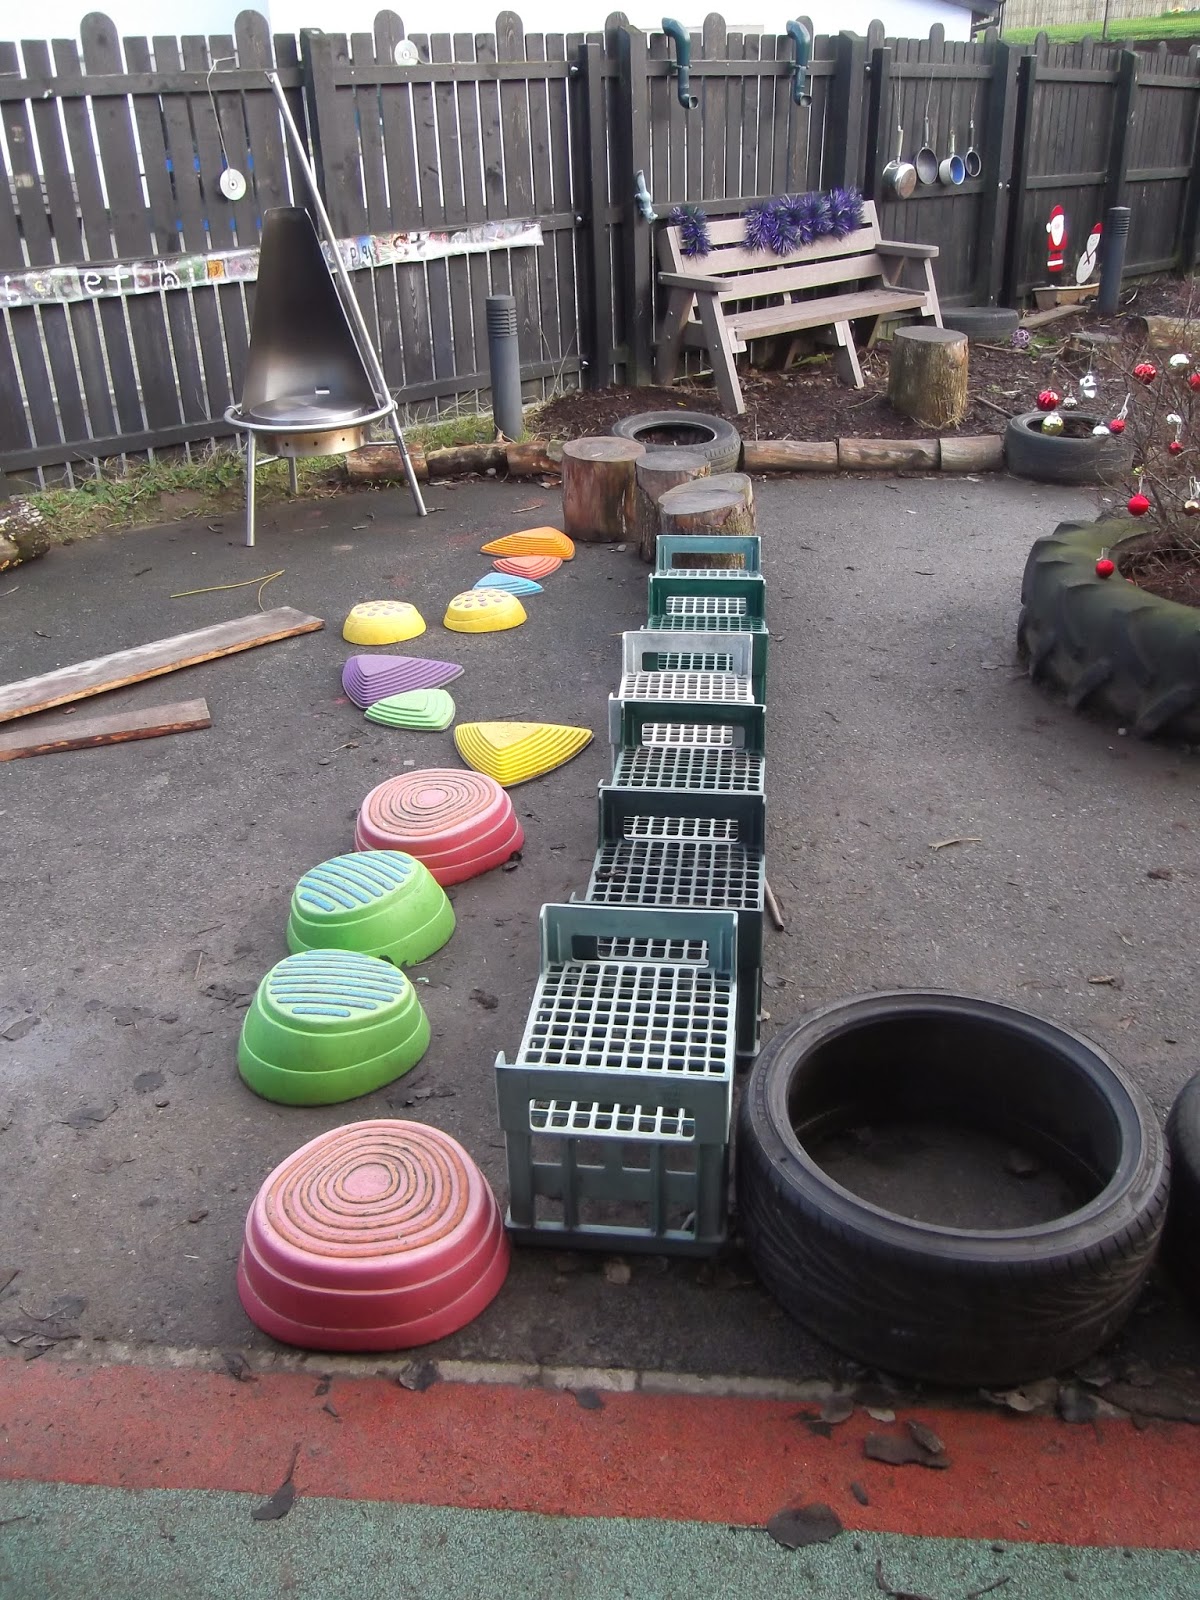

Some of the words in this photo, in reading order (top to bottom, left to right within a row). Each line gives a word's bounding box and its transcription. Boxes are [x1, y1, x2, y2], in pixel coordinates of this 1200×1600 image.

[83, 271, 105, 296] e
[108, 264, 129, 297] f
[157, 260, 181, 291] h
